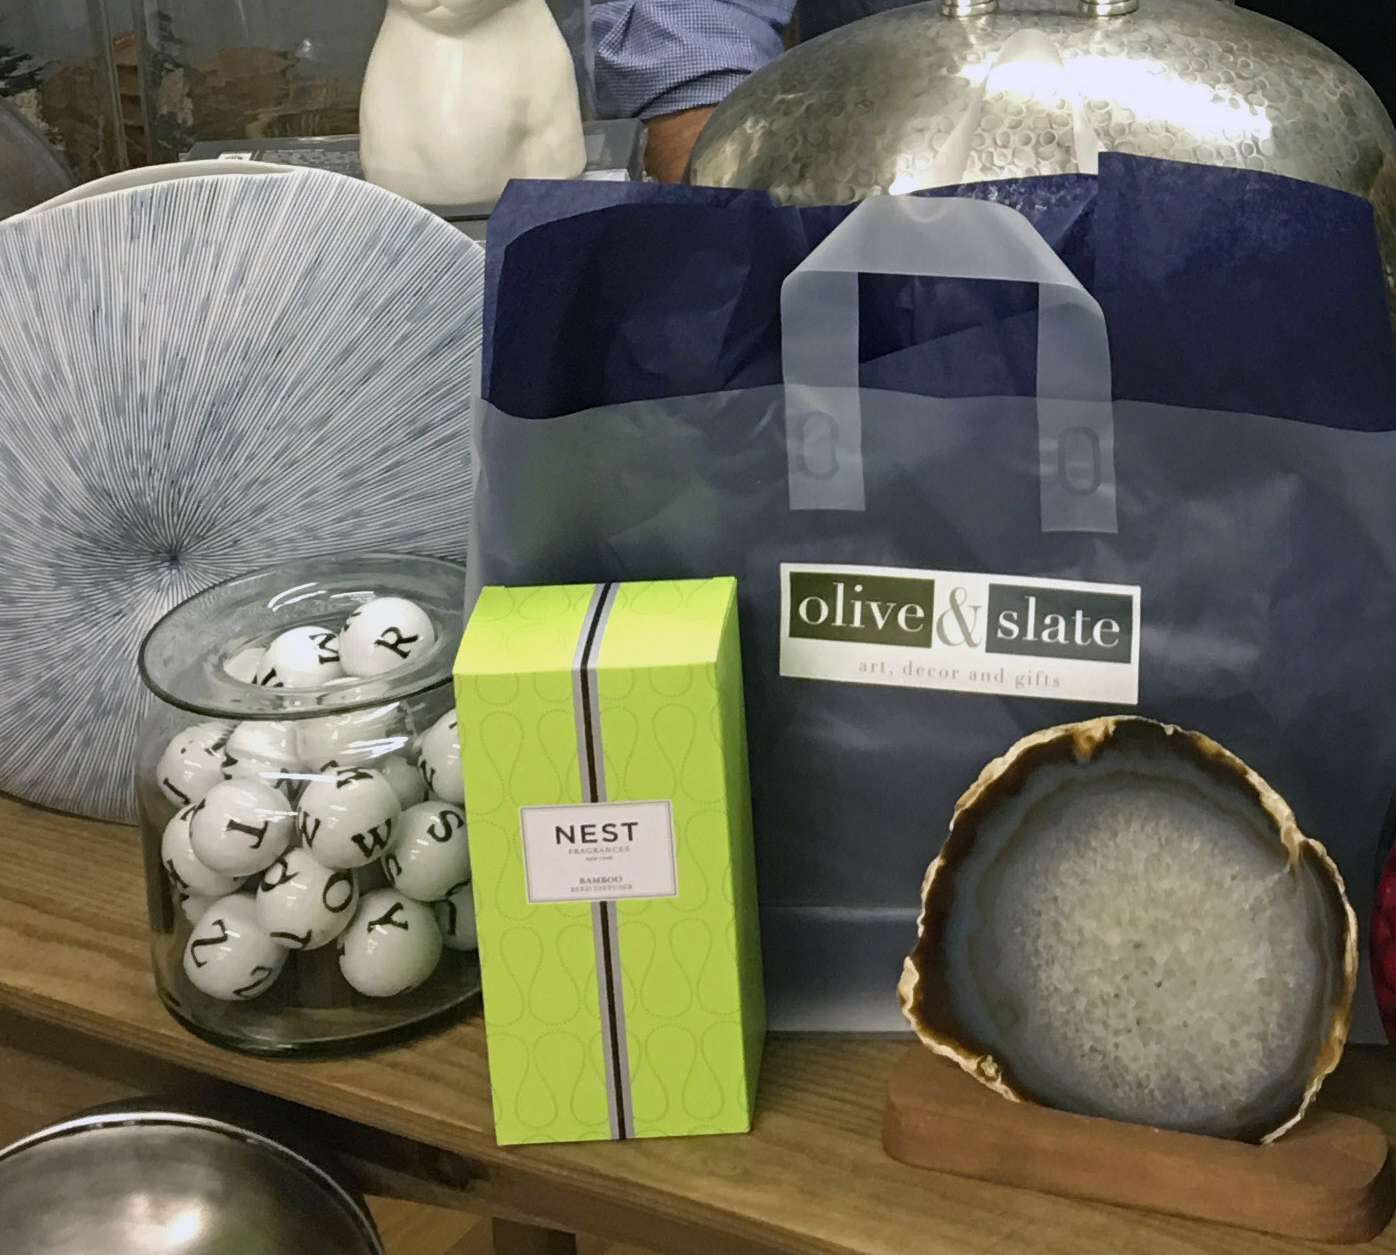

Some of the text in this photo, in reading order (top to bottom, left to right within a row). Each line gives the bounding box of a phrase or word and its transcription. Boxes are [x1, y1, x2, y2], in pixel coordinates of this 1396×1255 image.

[799, 581, 1121, 649] olive & slate
[374, 626, 419, 659] R
[858, 660, 1061, 689] art, decor and gifts
[426, 809, 465, 843] S
[554, 821, 639, 845] NEST
[579, 876, 623, 885] BAMBOO
[366, 901, 409, 934] Y
